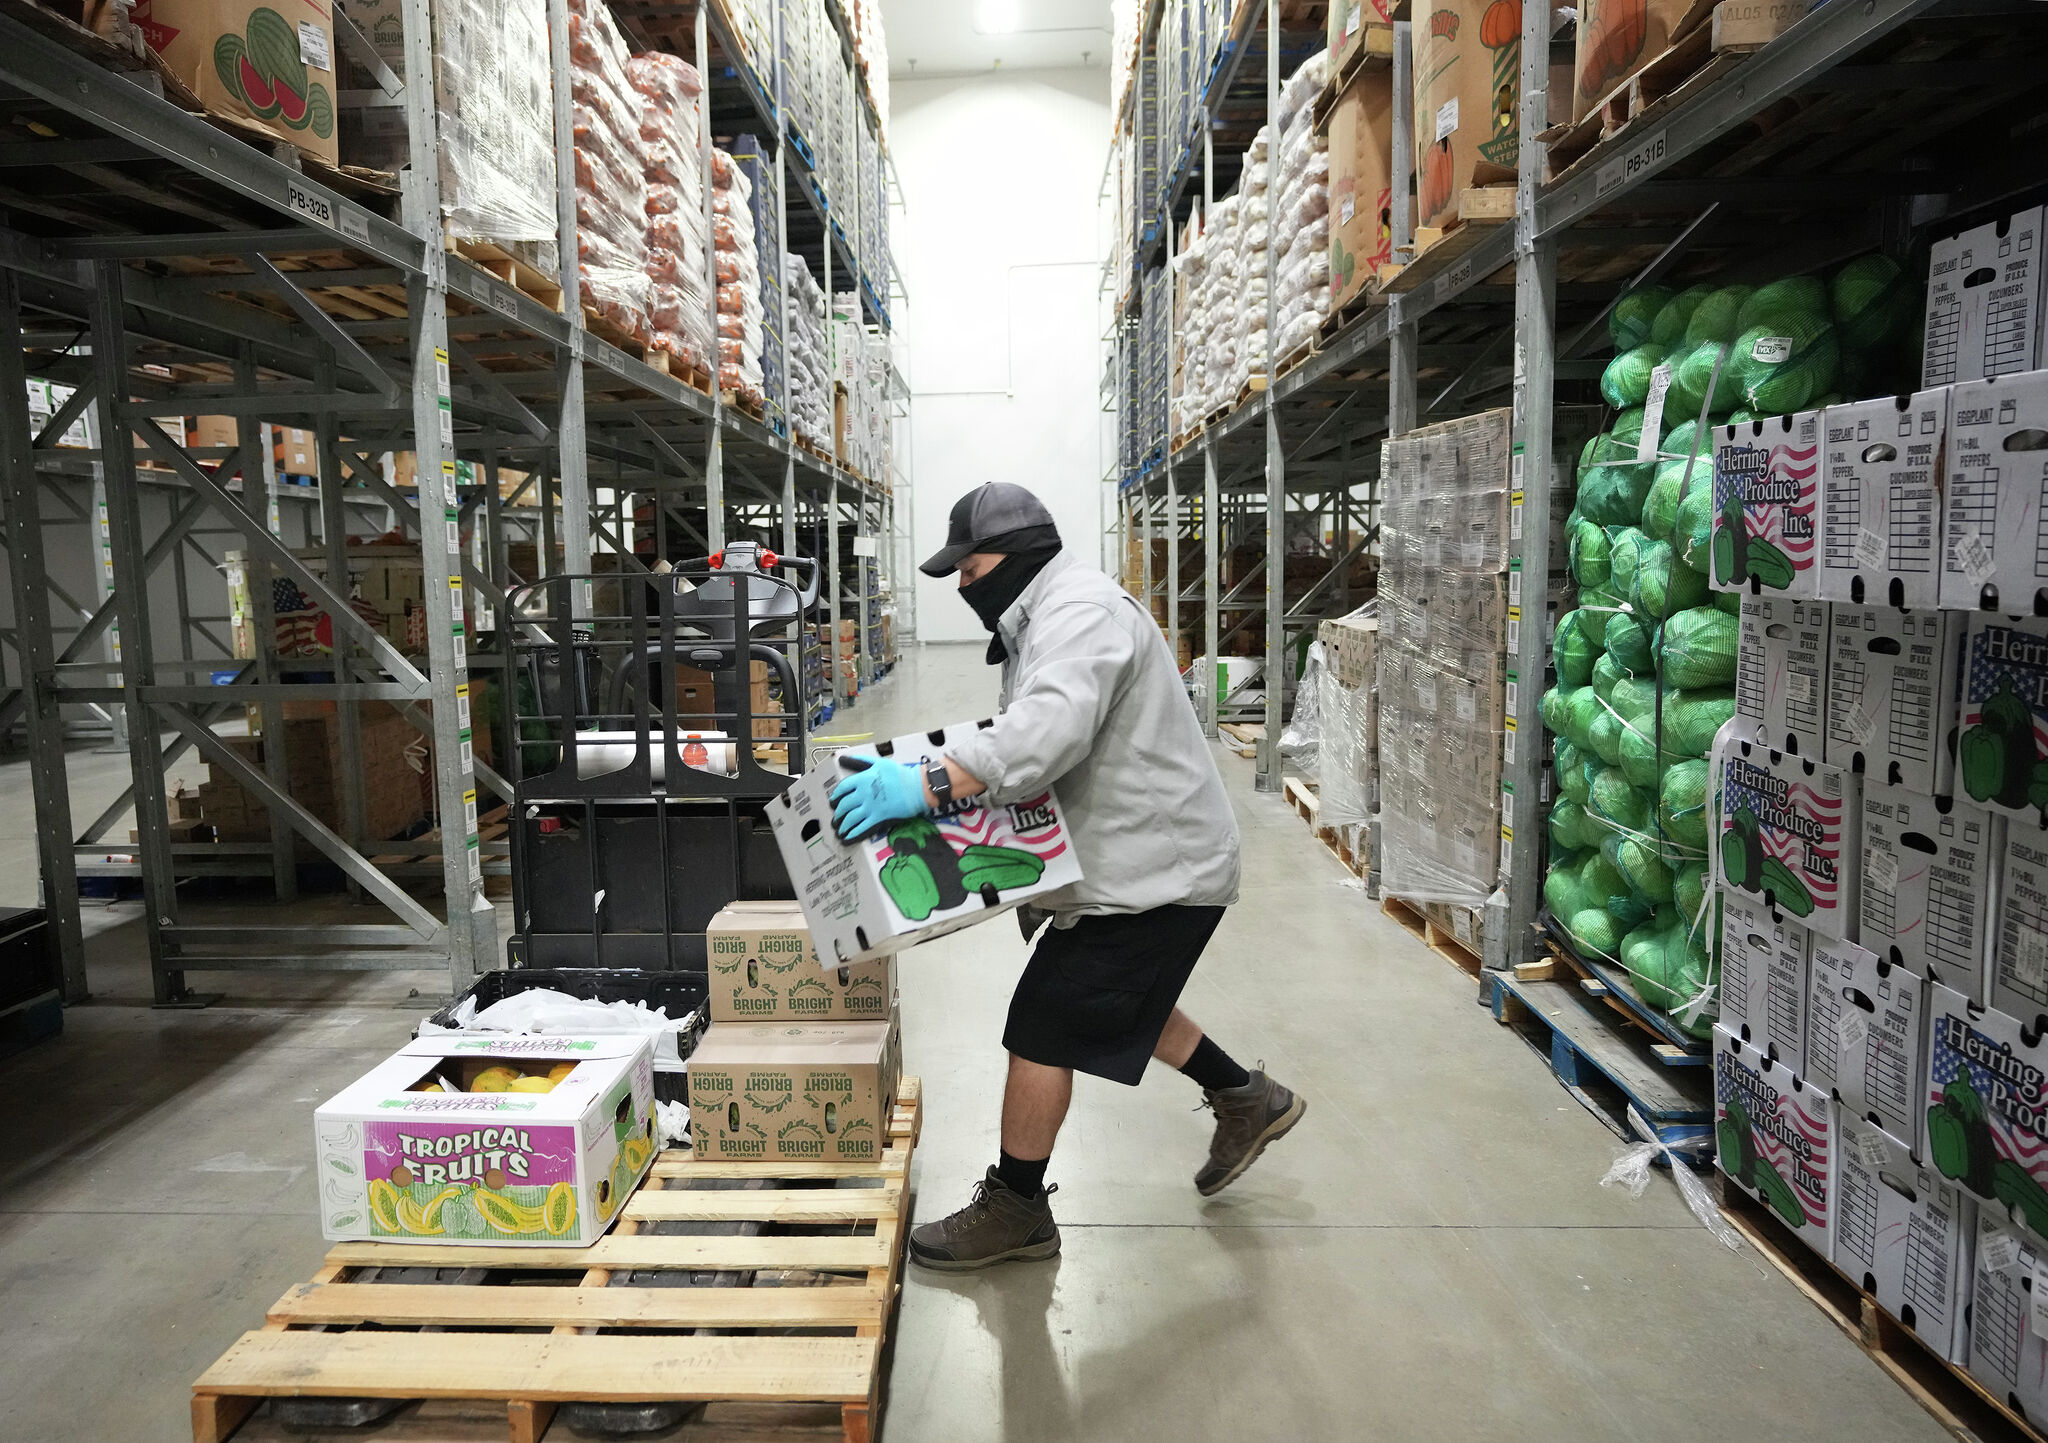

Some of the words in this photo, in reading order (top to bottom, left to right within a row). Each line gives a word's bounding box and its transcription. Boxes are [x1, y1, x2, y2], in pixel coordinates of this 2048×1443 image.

[1626, 138, 1665, 178] PB-31B
[289, 187, 329, 222] PB-32B
[1721, 442, 1768, 476] Herring
[1744, 475, 1800, 502] Produce
[1783, 507, 1812, 535] Inc.
[1986, 628, 2048, 668] Herr
[1732, 759, 1787, 804] Herring
[1010, 803, 1056, 832] Inc.
[1760, 797, 1823, 841] Produce
[1804, 843, 1836, 879] Inc.
[758, 940, 803, 953] BRIGHT
[733, 998, 778, 1011] BRIGHT
[788, 997, 833, 1010] BRIGHT
[844, 996, 882, 1009] BRIGH
[1946, 1016, 2041, 1099] Herring
[694, 1078, 733, 1091] BRIGH
[745, 1078, 793, 1091] BRIGHT
[804, 1078, 853, 1092] BRIGHT
[1725, 1053, 1777, 1109] Herring
[398, 1126, 535, 1158] TROPICAL
[1751, 1099, 1811, 1157] Produce
[720, 1139, 767, 1153] BRIGHT
[778, 1140, 826, 1153] BRIGHT
[401, 1149, 530, 1186] FRUITS
[1794, 1157, 1824, 1200] Inc.
